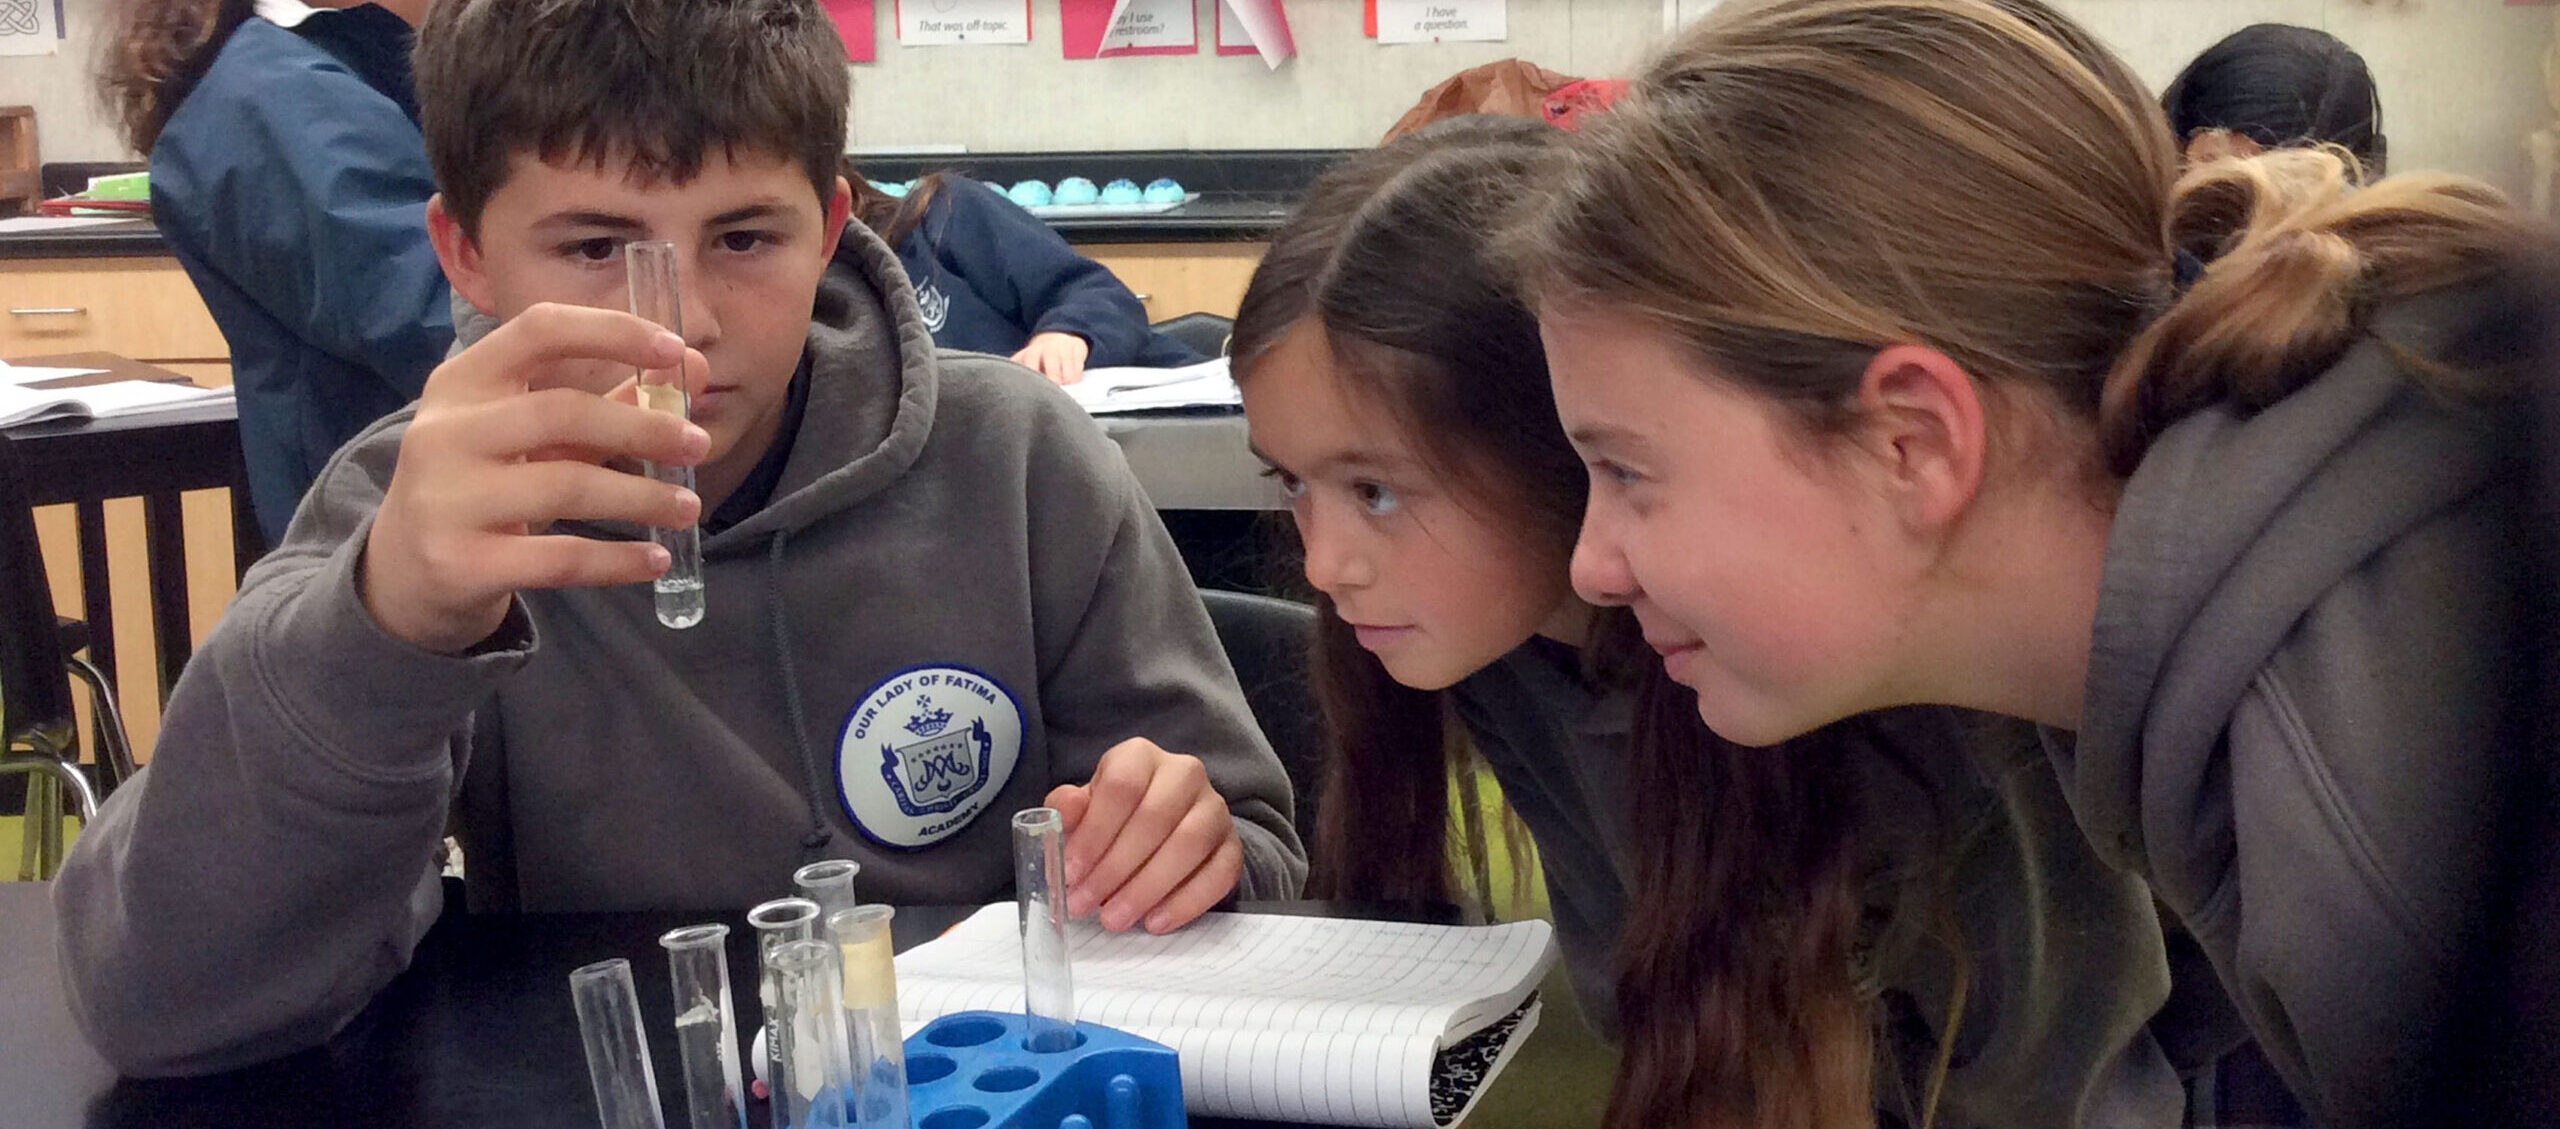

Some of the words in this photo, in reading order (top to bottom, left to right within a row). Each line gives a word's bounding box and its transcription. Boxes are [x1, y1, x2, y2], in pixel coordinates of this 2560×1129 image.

[1136, 13, 1154, 23] use
[1432, 6, 1457, 17] have
[920, 21, 941, 32] That
[944, 22, 964, 31] was
[855, 708, 878, 740] OUR
[876, 679, 913, 708] LADY
[919, 674, 940, 687] OF
[945, 674, 997, 704] FATIMA
[918, 802, 980, 837] ACADEMY
[768, 1017, 783, 1062] KIMAX
